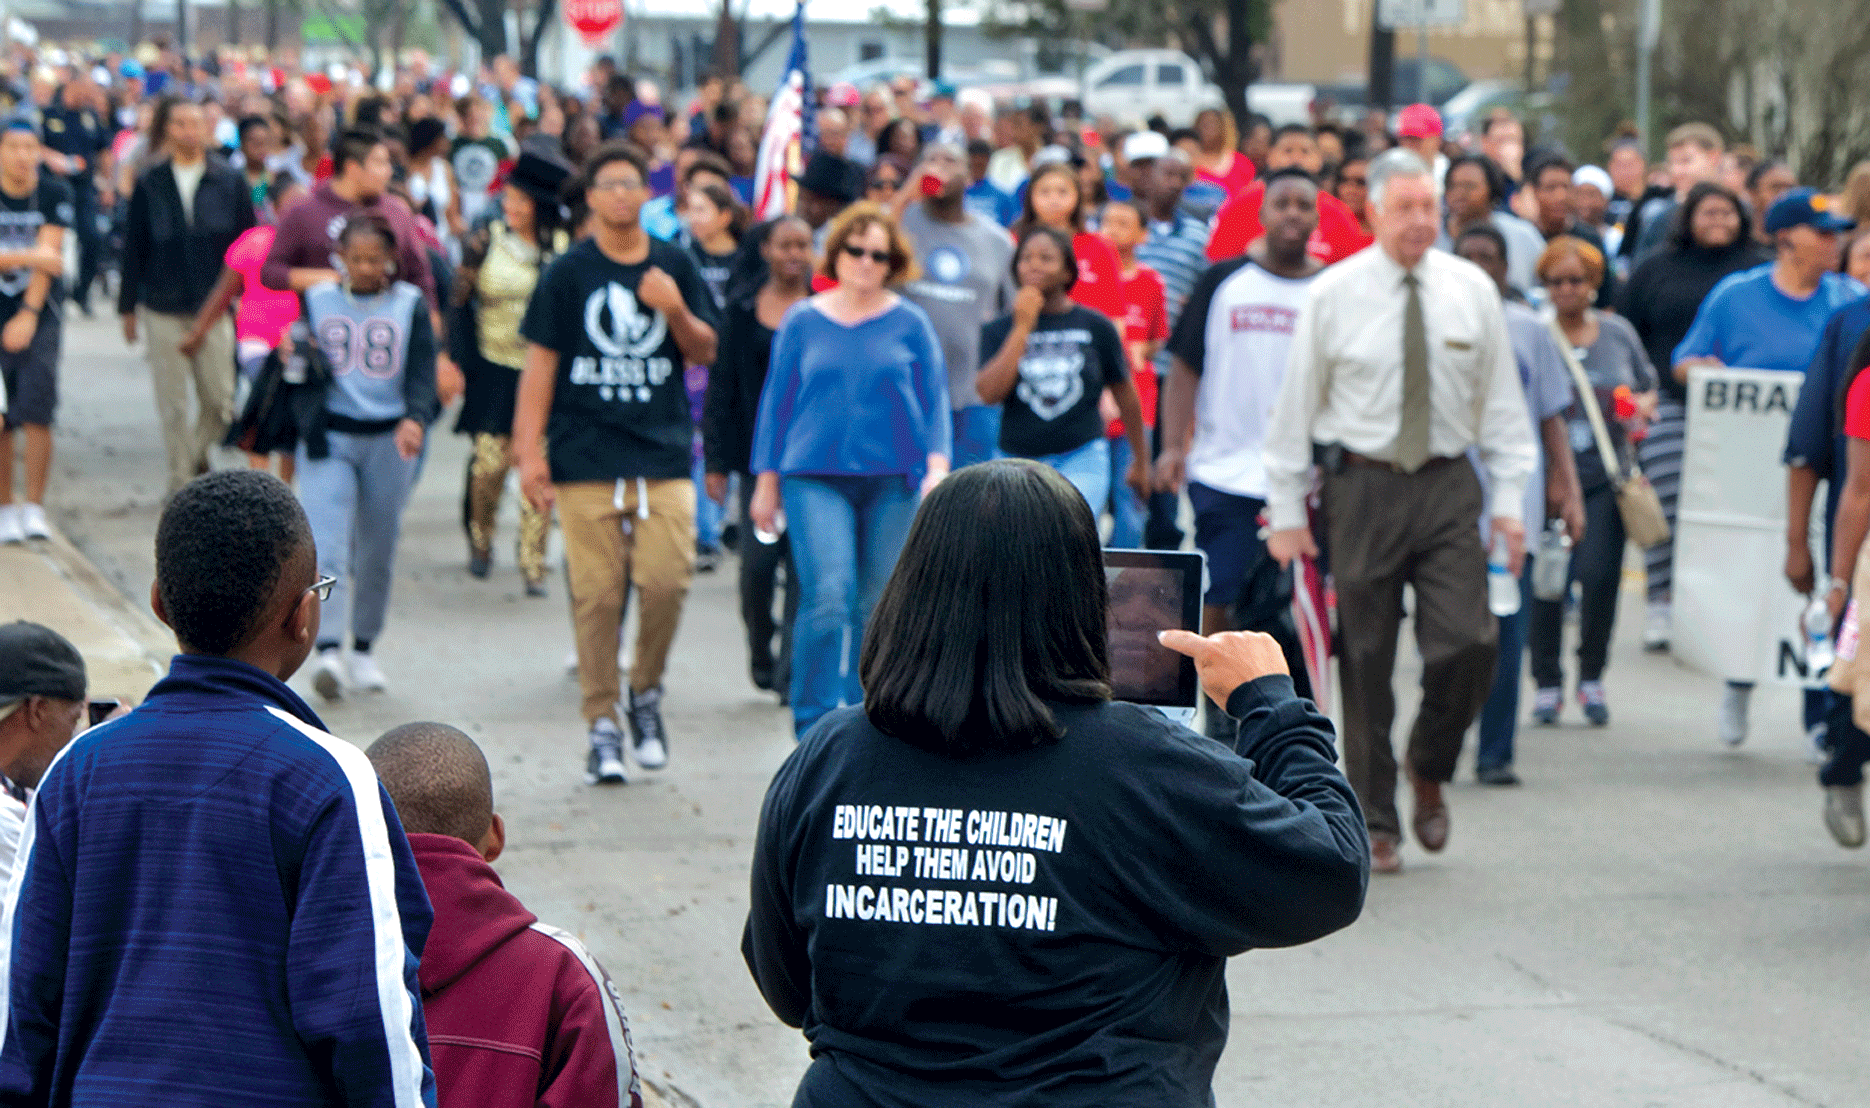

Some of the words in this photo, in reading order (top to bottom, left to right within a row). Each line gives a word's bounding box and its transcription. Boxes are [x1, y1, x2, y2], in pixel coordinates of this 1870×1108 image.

[318, 315, 400, 378] 98
[646, 357, 673, 385] UP
[832, 804, 920, 842] EDUCATE
[923, 806, 963, 843] THE
[966, 809, 1067, 853] CHILDREN
[856, 843, 909, 877] HELP
[914, 846, 969, 880] THEM
[971, 850, 1037, 884] AVOID
[825, 883, 1058, 931] INCARCERATION!
